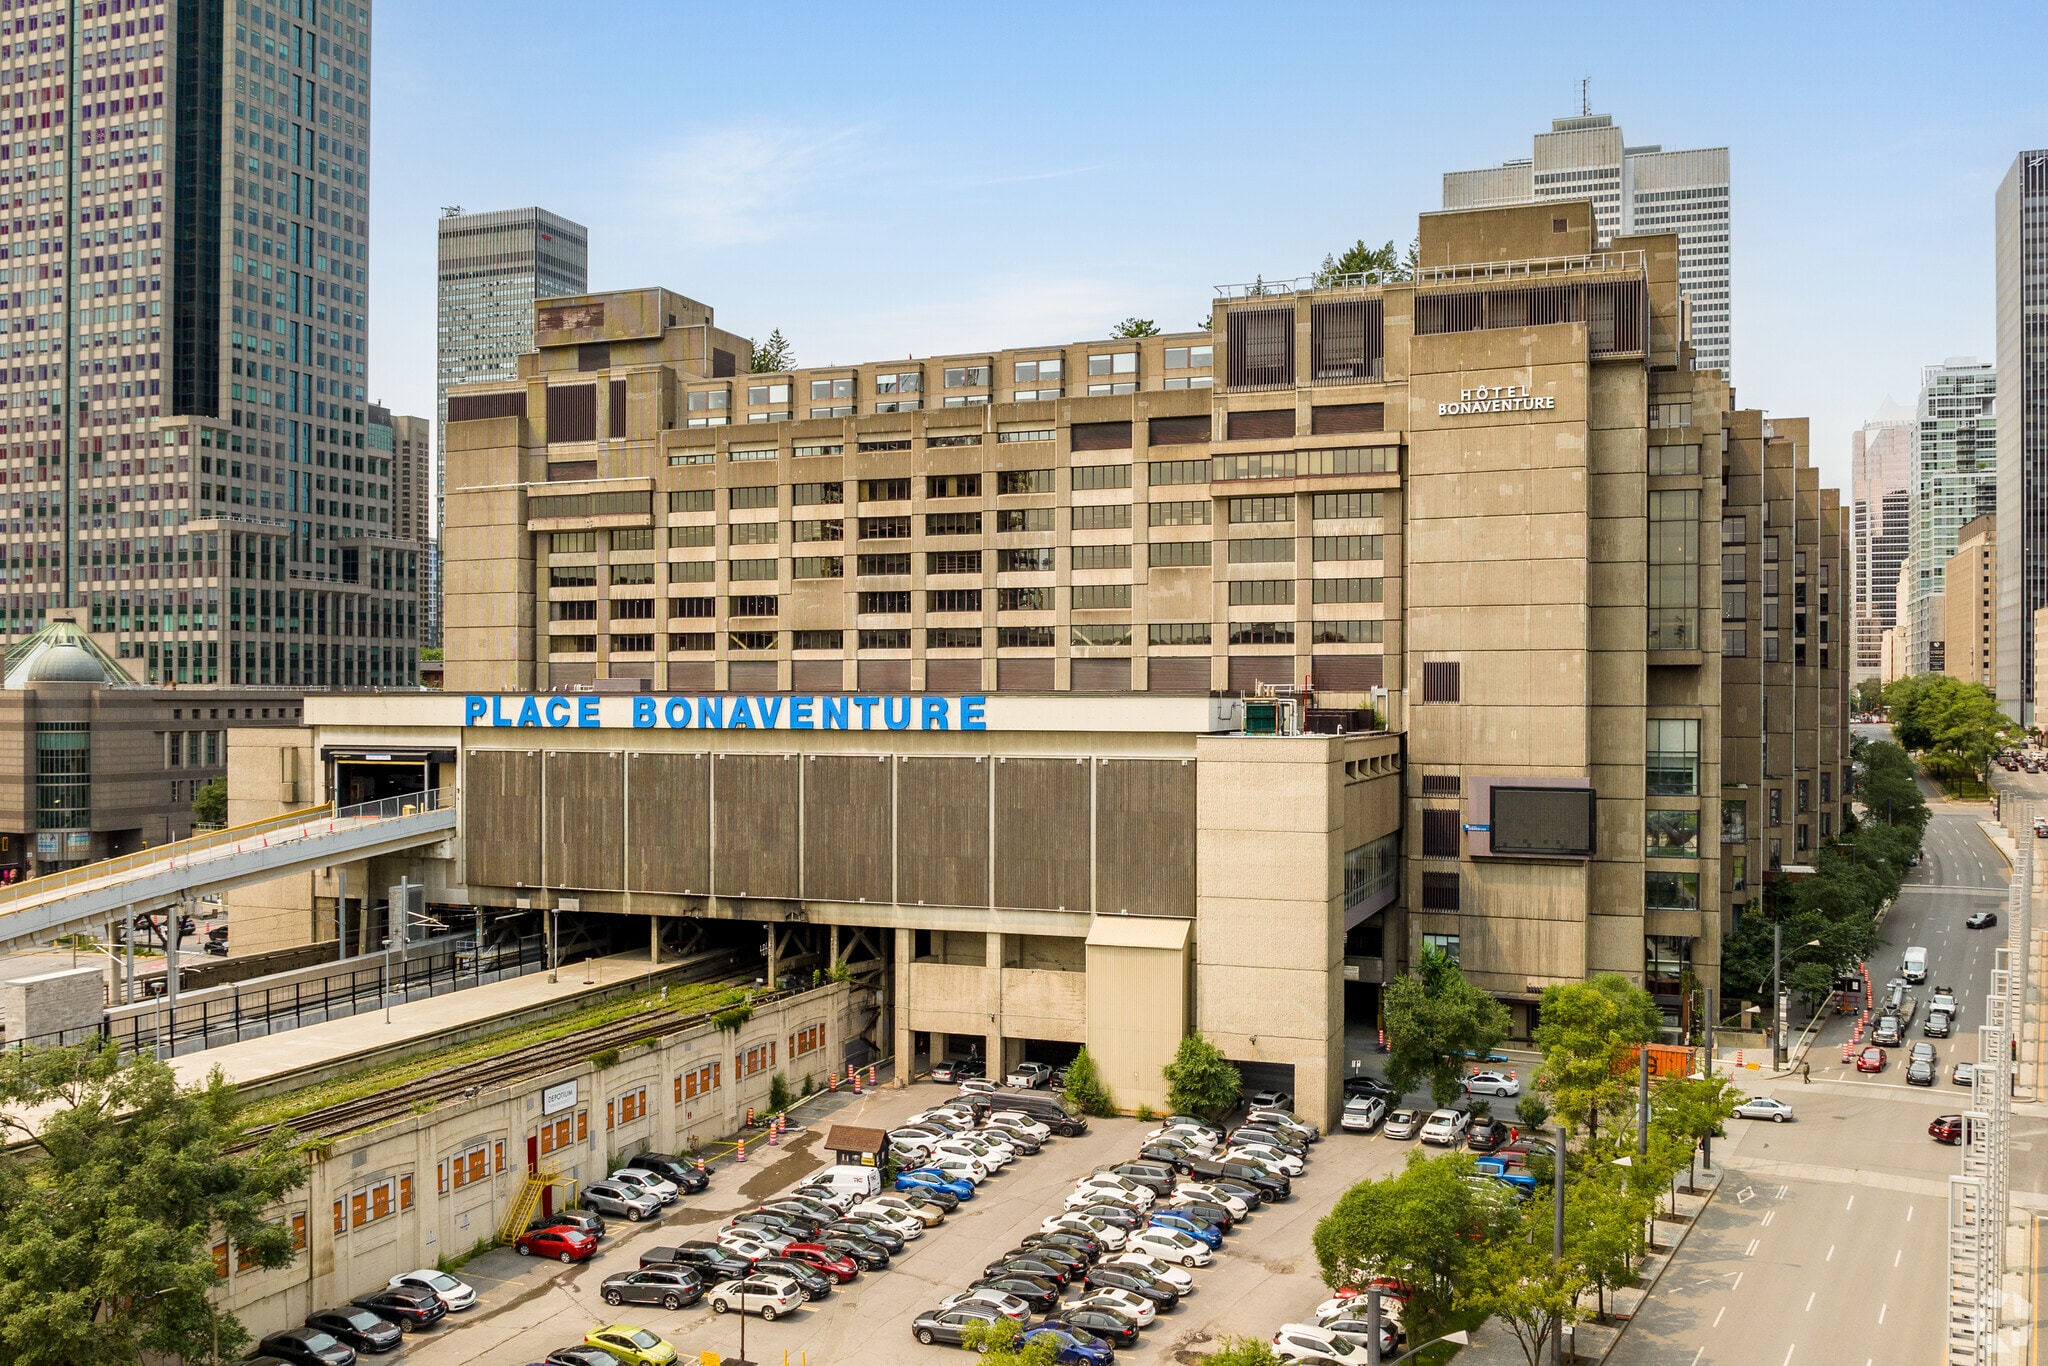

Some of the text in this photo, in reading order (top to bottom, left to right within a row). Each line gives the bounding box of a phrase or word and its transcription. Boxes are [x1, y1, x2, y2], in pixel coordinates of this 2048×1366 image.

[1461, 385, 1530, 402] HÔTEL
[1438, 397, 1555, 416] BONAVENTURE
[465, 695, 987, 731] PLACE BONAVENTURE
